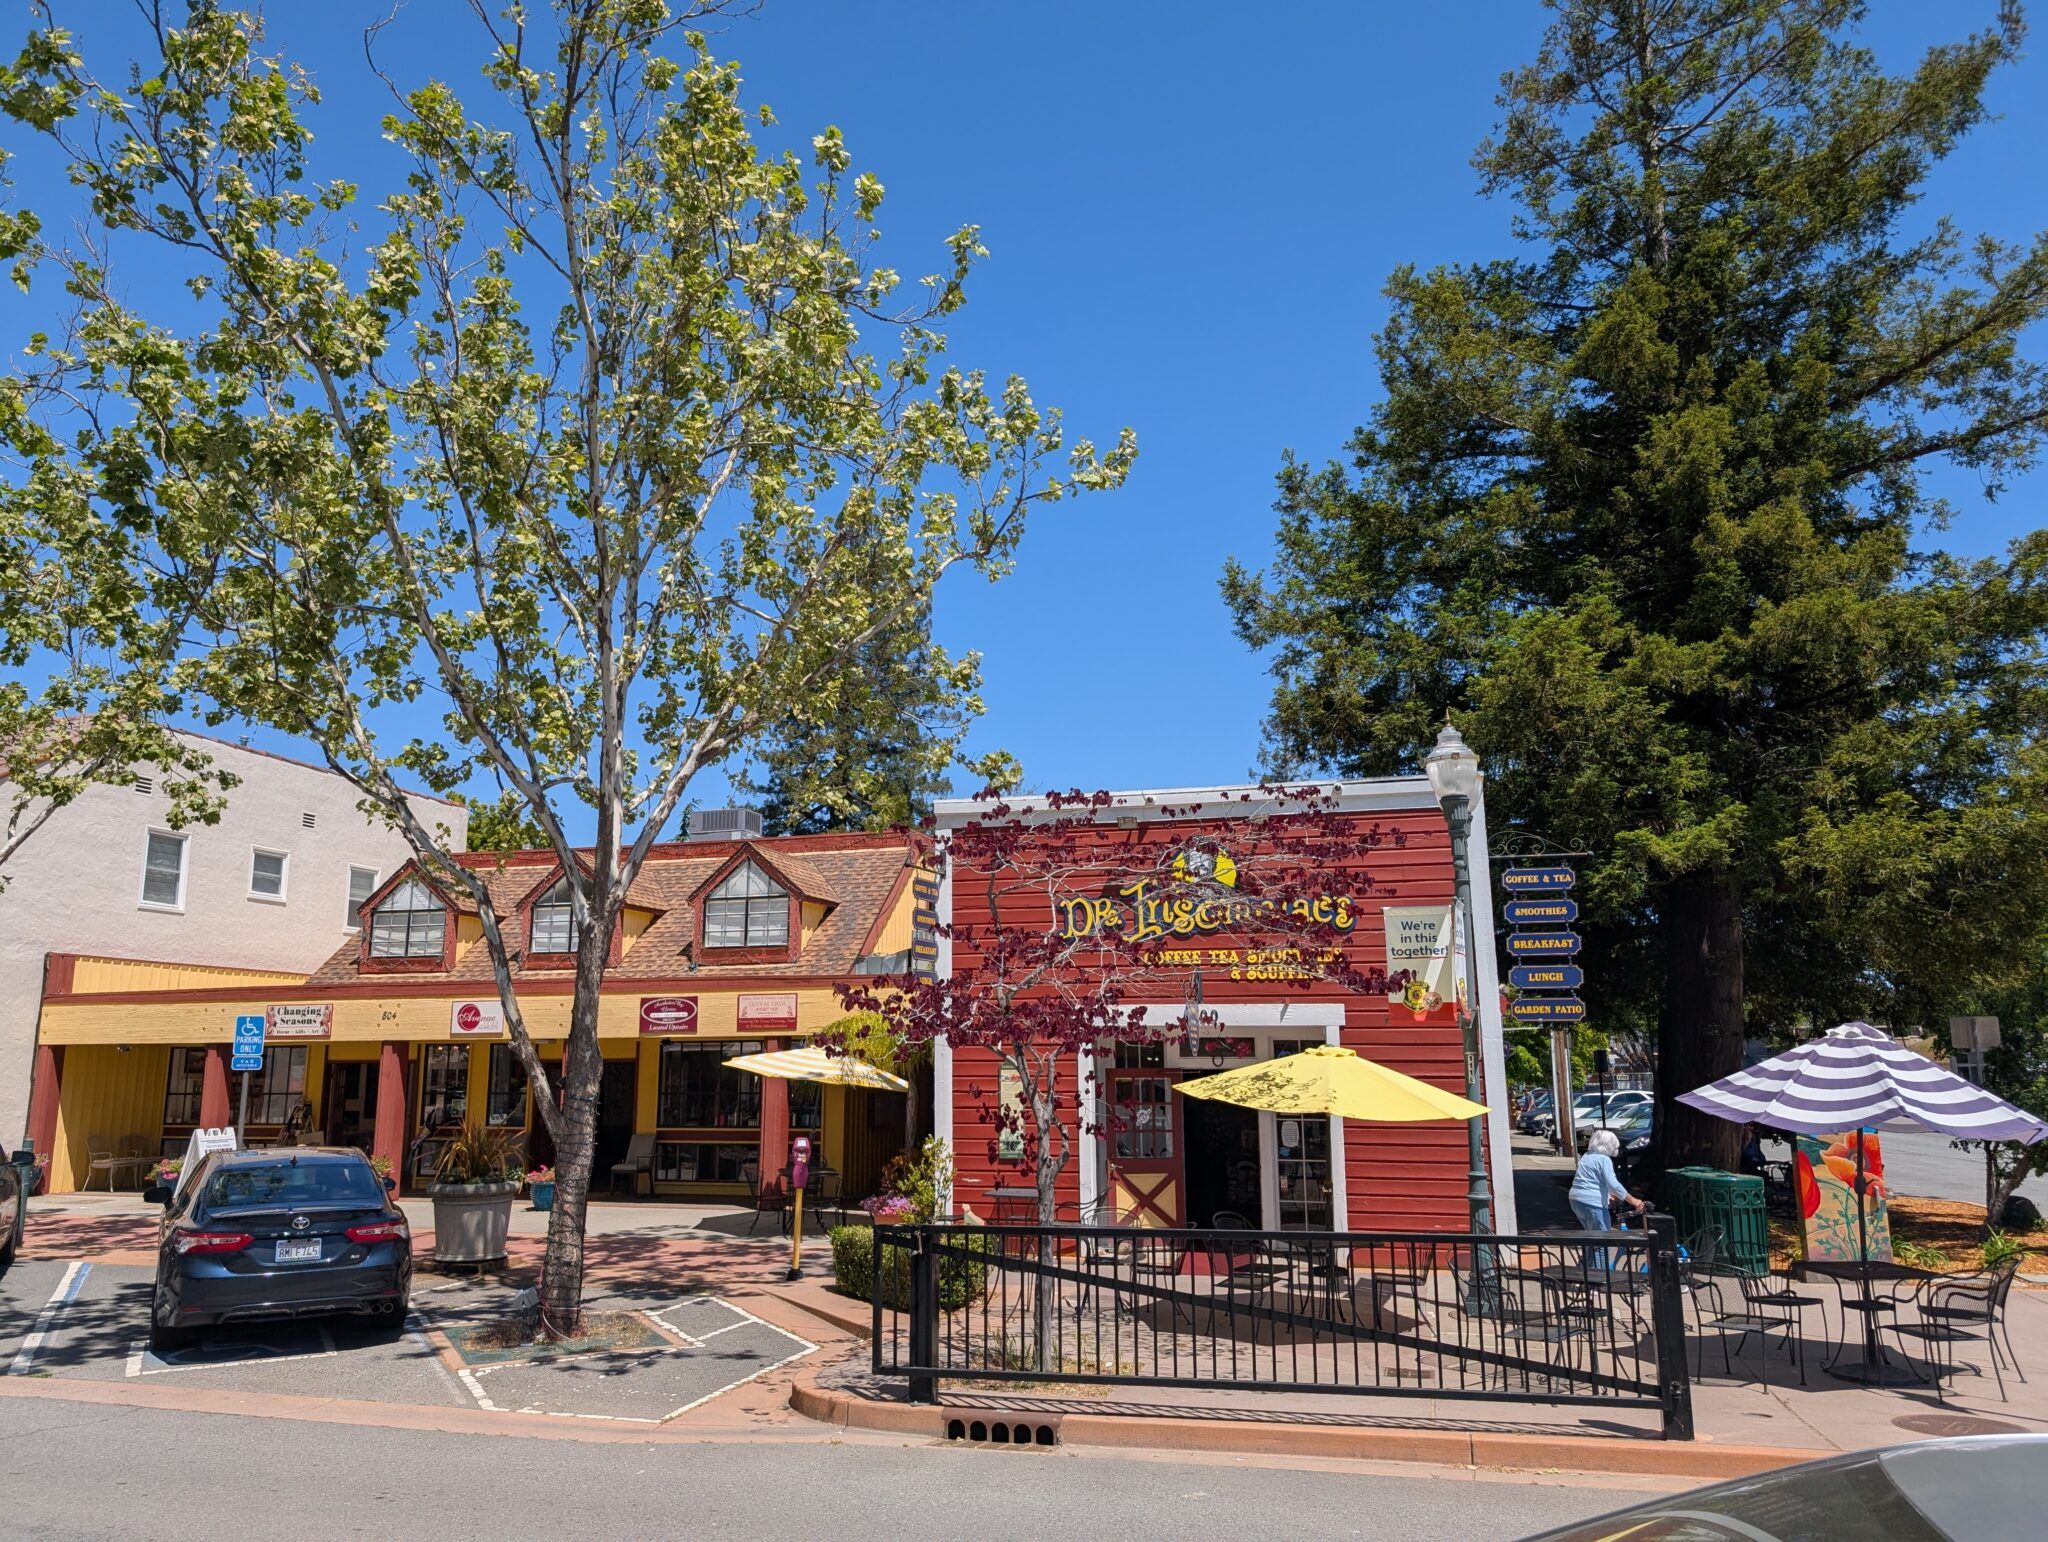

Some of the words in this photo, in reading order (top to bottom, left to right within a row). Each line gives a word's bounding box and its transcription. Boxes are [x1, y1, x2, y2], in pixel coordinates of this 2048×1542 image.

[1505, 875, 1539, 884] COFFEE
[1542, 874, 1550, 883] &
[1553, 874, 1572, 882] TEA
[1514, 906, 1568, 916] SMOOTHIES
[1401, 920, 1436, 931] We're
[1400, 933, 1412, 943] in
[1415, 933, 1438, 943] this
[1513, 939, 1574, 949] BREAKFAST
[1208, 949, 1239, 964] TEA
[1247, 947, 1343, 964] SMOOTES
[1391, 945, 1449, 958] together!
[1230, 966, 1241, 980] &
[1528, 972, 1564, 982] LUNCH
[277, 1006, 322, 1018] Changing
[1514, 1005, 1551, 1014] GARDEN
[1555, 1005, 1582, 1014] PATIO
[280, 1017, 317, 1026] Seasons
[236, 1036, 262, 1044] PARKING
[240, 1045, 257, 1053] ONLY
